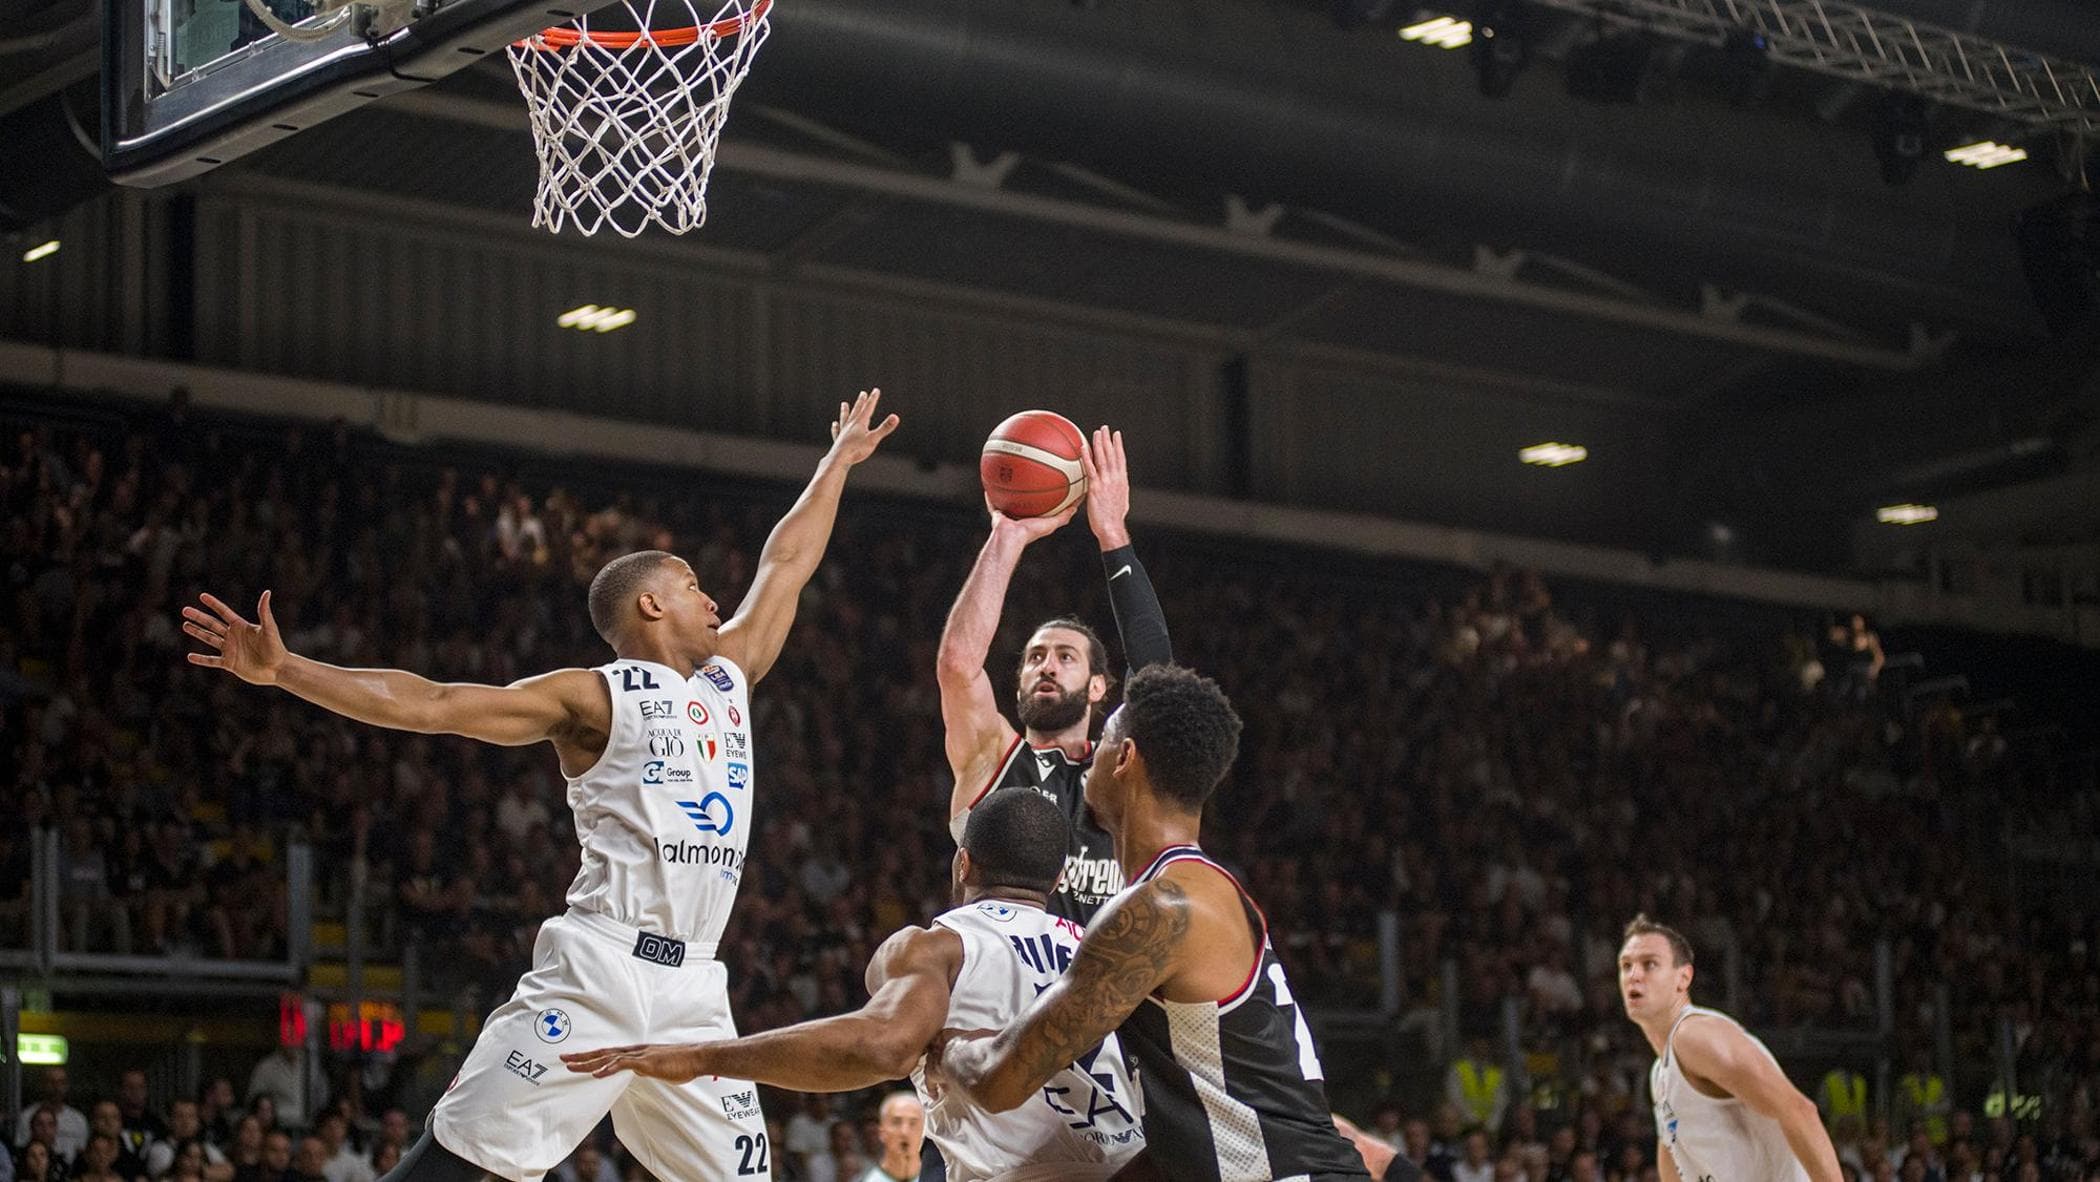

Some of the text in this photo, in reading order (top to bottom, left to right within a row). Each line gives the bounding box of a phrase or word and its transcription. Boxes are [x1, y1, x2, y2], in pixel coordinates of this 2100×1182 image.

[612, 666, 660, 692] 22
[639, 700, 673, 717] EA7
[649, 735, 685, 758] GIÒ
[666, 767, 692, 779] Group
[653, 837, 744, 872] almon
[506, 1049, 549, 1080] EA7
[734, 1132, 768, 1177] 22
